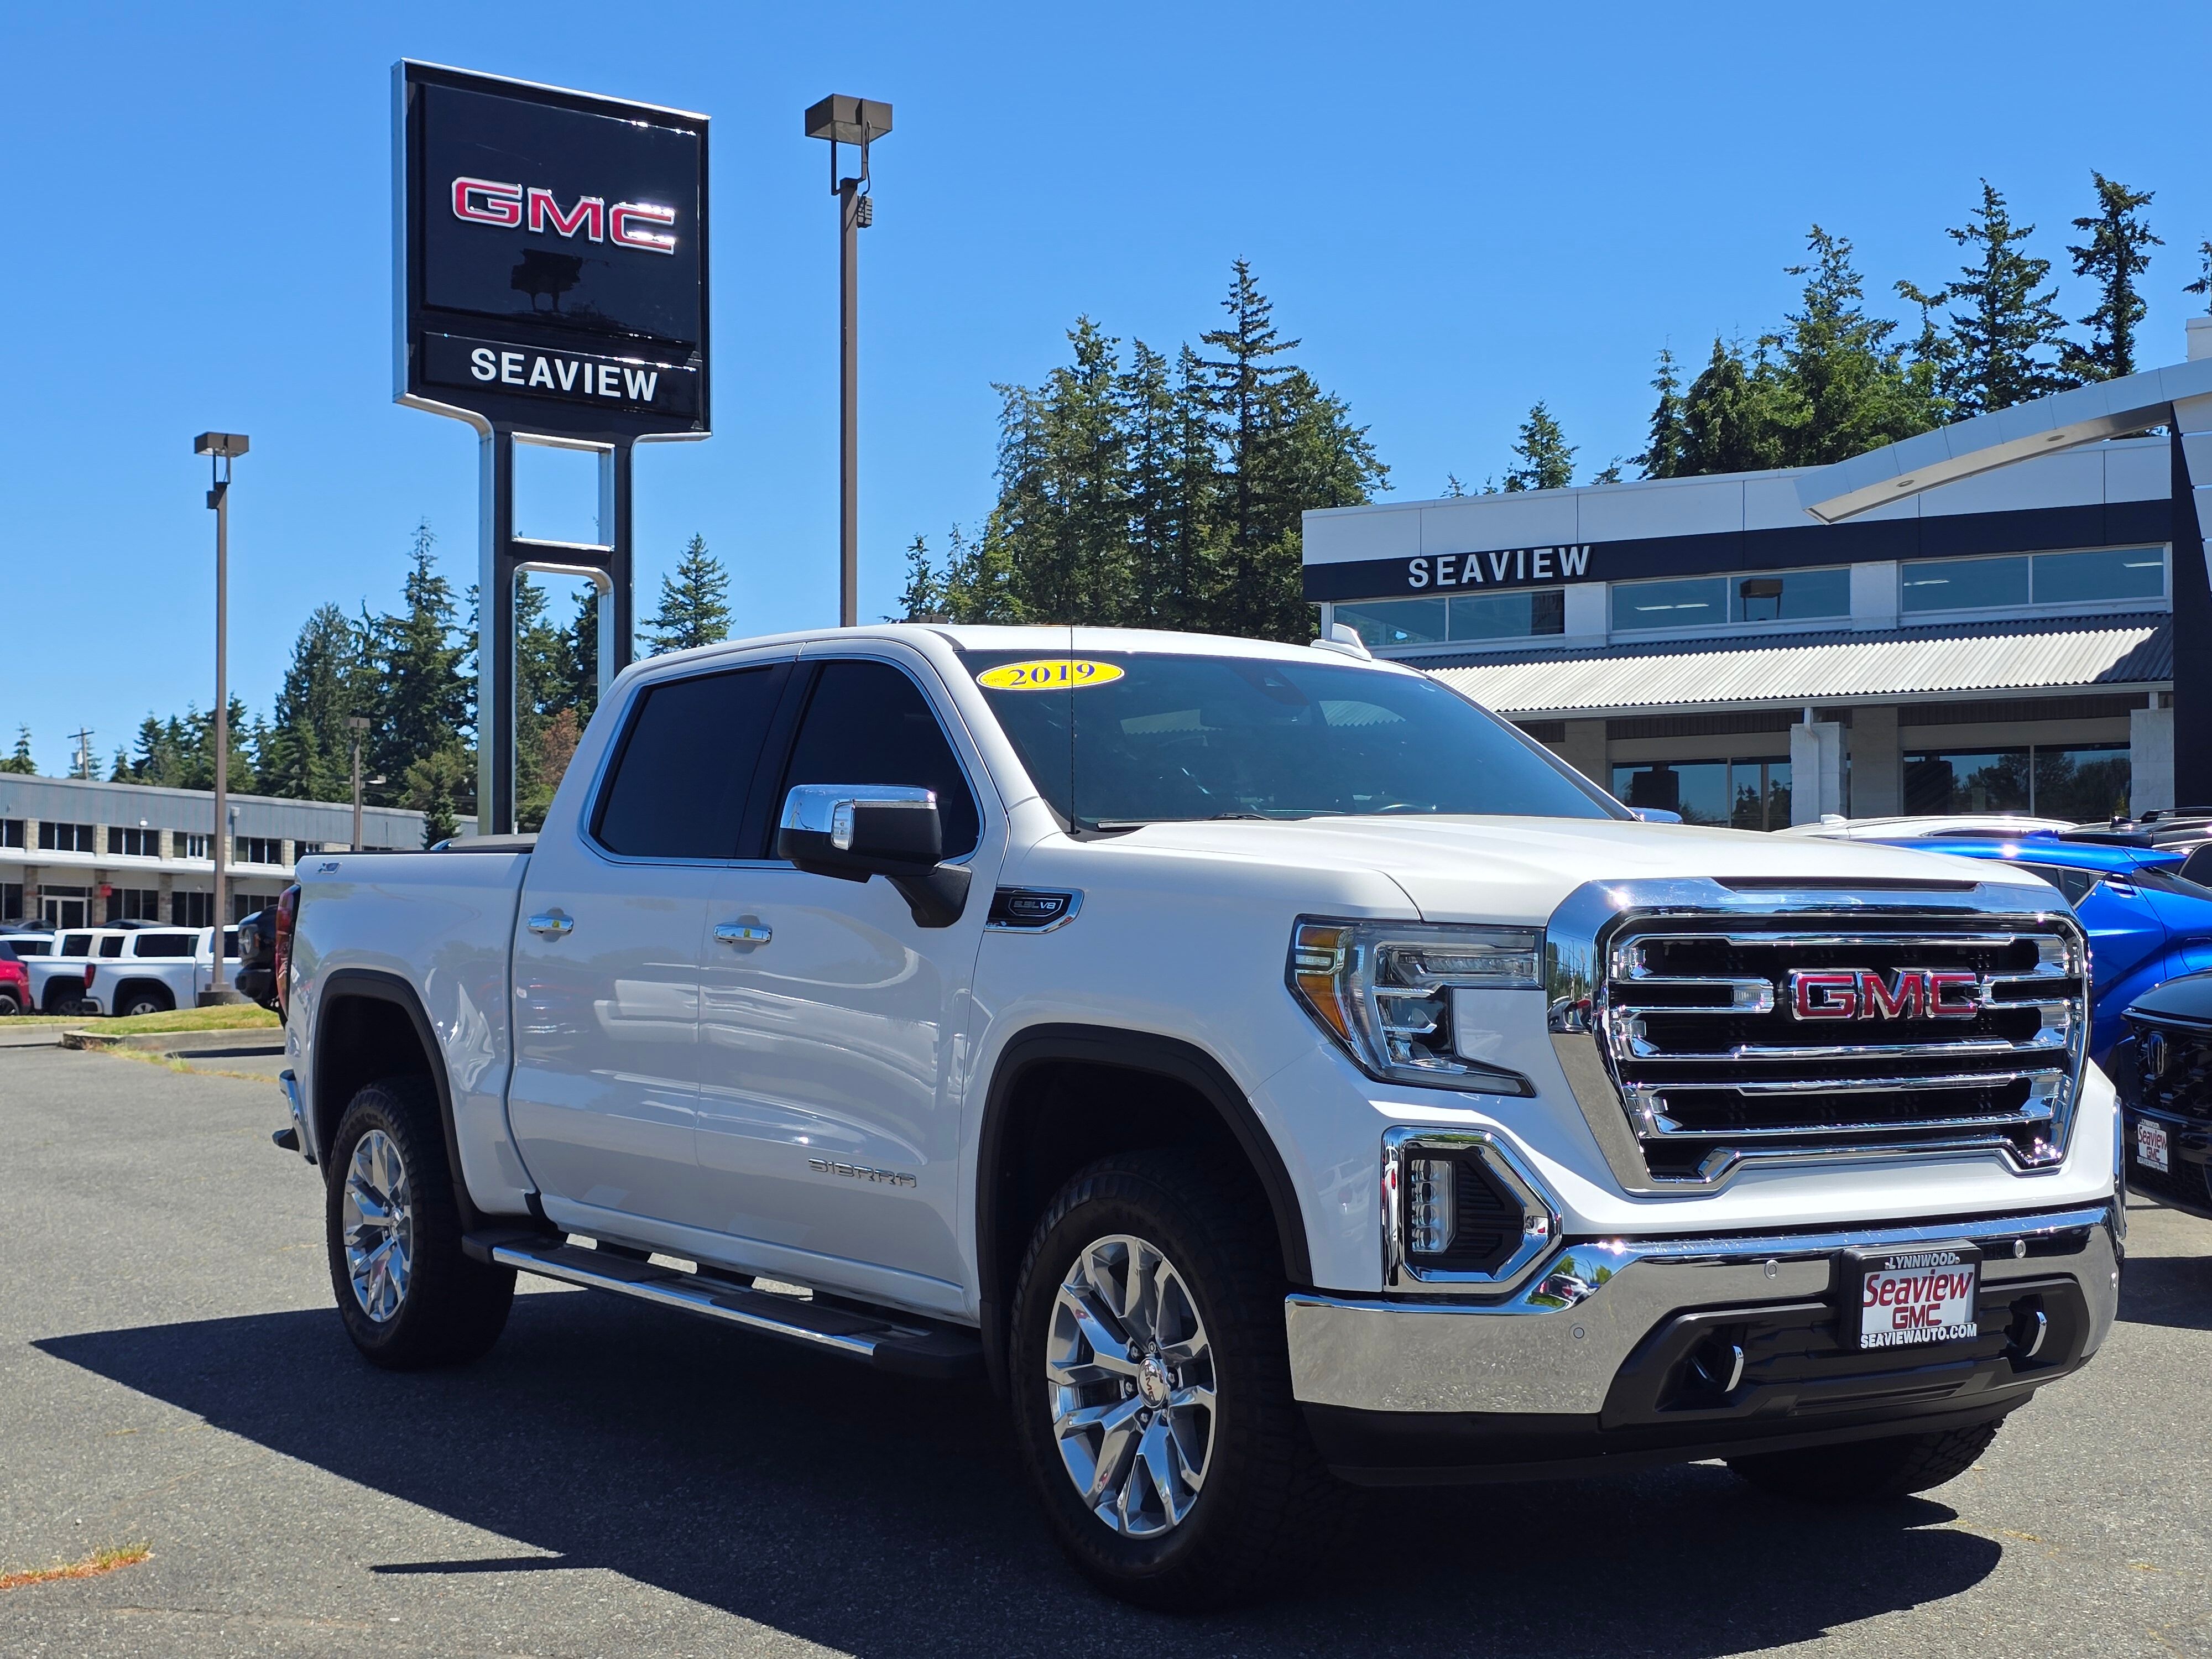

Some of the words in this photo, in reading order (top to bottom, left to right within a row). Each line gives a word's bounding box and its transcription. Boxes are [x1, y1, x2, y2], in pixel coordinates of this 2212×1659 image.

[451, 176, 675, 255] GMC
[471, 347, 658, 401] SEAVIEW
[1408, 545, 1593, 588] SEAVIEW
[1008, 664, 1095, 686] 2019
[1791, 969, 1978, 1021] GMC
[808, 1157, 917, 1188] SIERRA
[1888, 1252, 1955, 1270] LYNNWOOD
[1863, 1269, 1973, 1307] Seaview
[1892, 1303, 1942, 1329] GMC
[1860, 1323, 1977, 1349] SEAVIEWAUTO.COM
